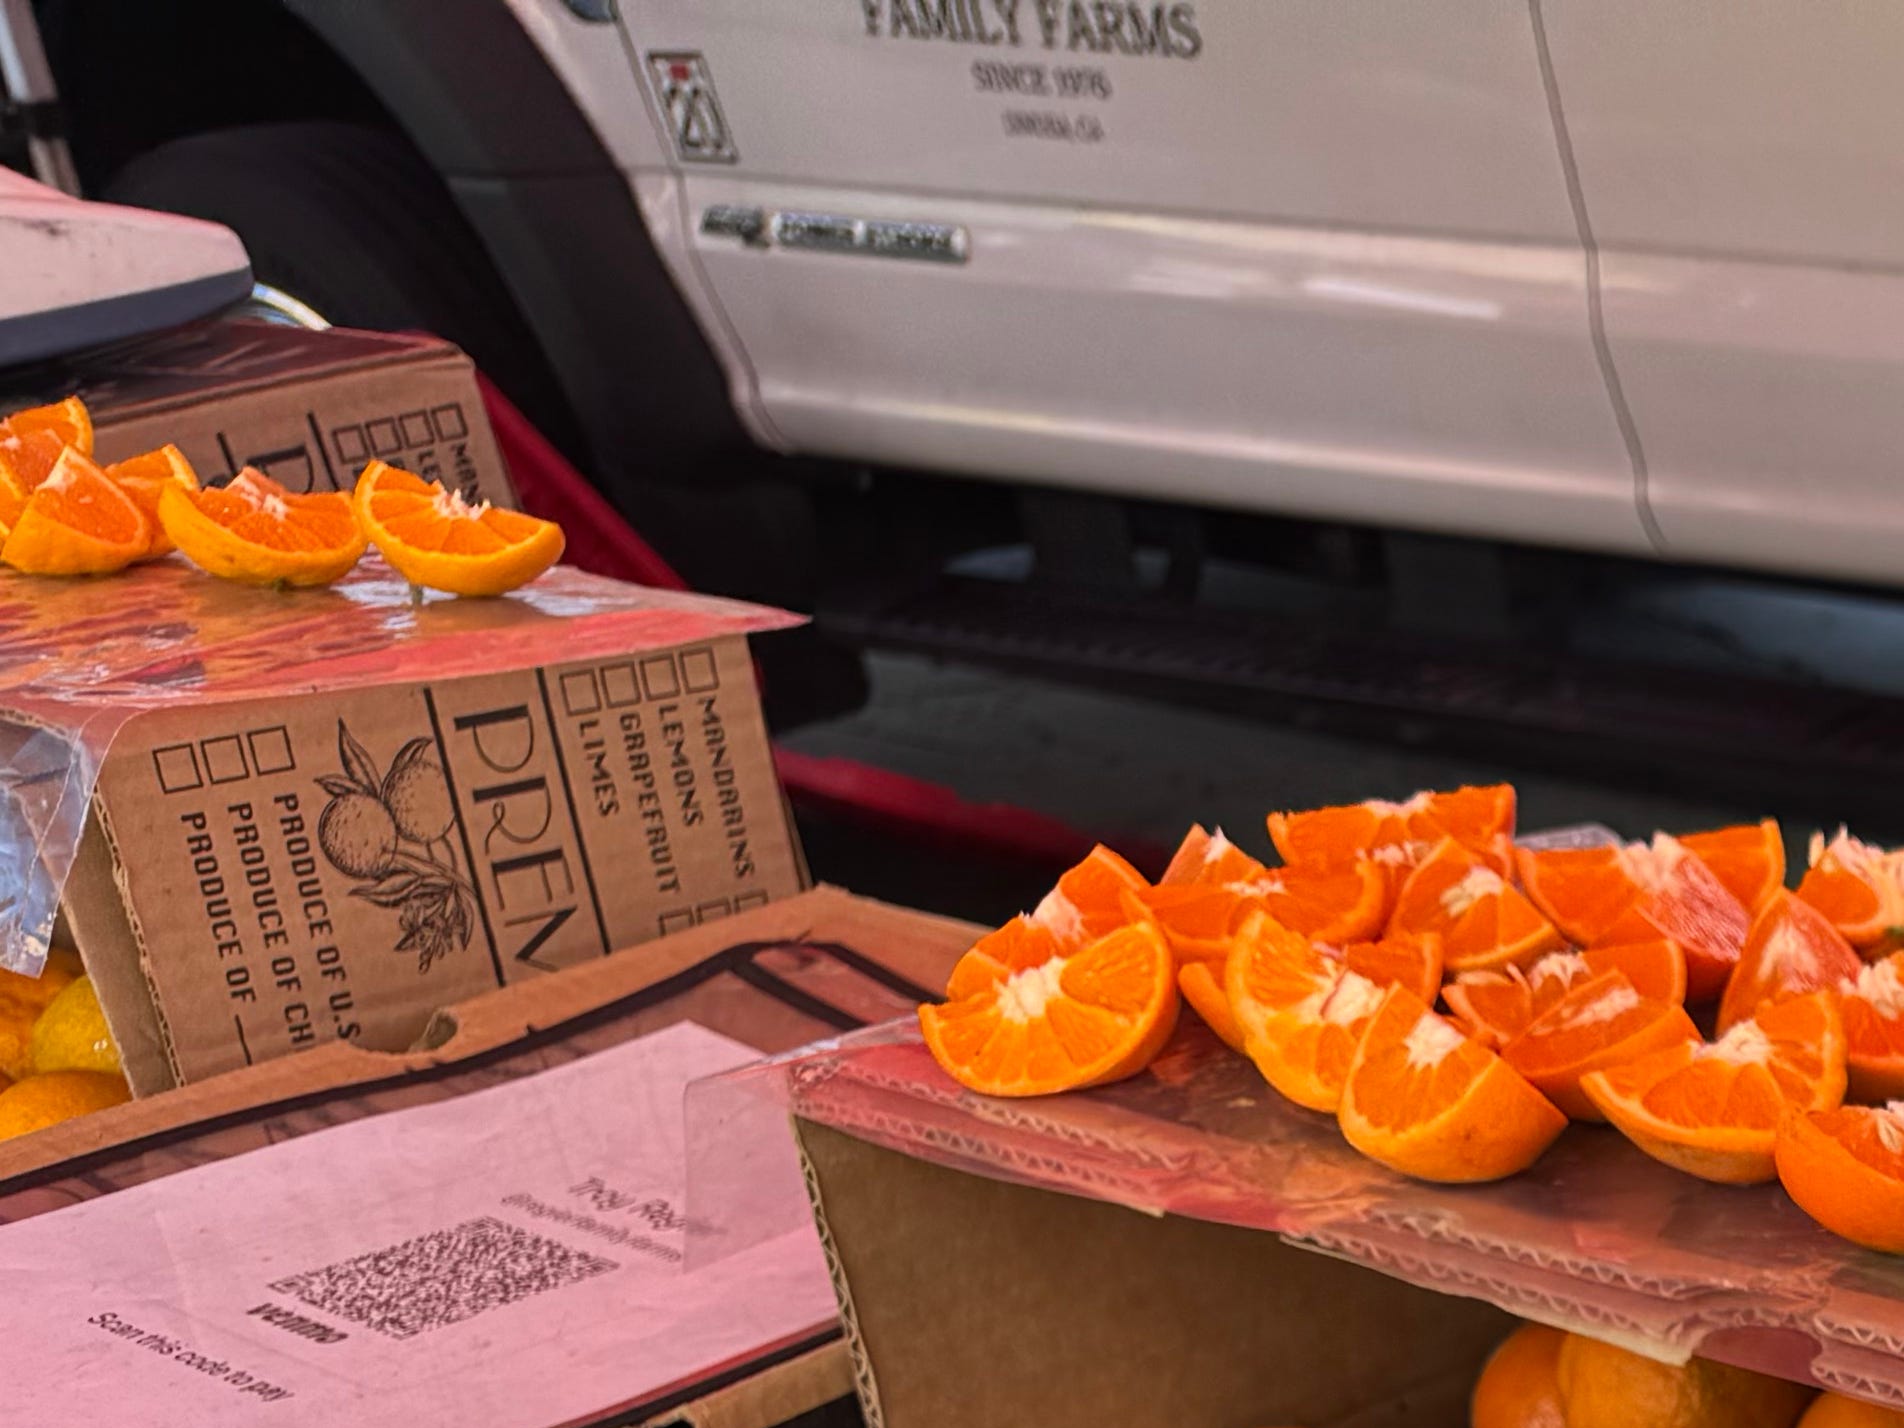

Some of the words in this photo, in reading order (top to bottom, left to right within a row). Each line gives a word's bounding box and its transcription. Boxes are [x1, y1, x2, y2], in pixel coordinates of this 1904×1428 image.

[1036, 0, 1203, 59] FARMS
[579, 718, 620, 819] LIMES
[619, 710, 681, 895] GRAPEFRUIT
[658, 704, 704, 828] LEMONS
[698, 694, 755, 880] MANDARINS
[180, 811, 243, 960] PRODUCE
[225, 966, 257, 1004] OF
[227, 801, 289, 950] PRODUCE
[271, 955, 302, 993] OF
[273, 793, 333, 939] PRODUCE
[316, 945, 347, 982] OF
[88, 1312, 144, 1340] Scan
[175, 1351, 230, 1376] code
[224, 1370, 254, 1386] to
[238, 1380, 295, 1402] pay
